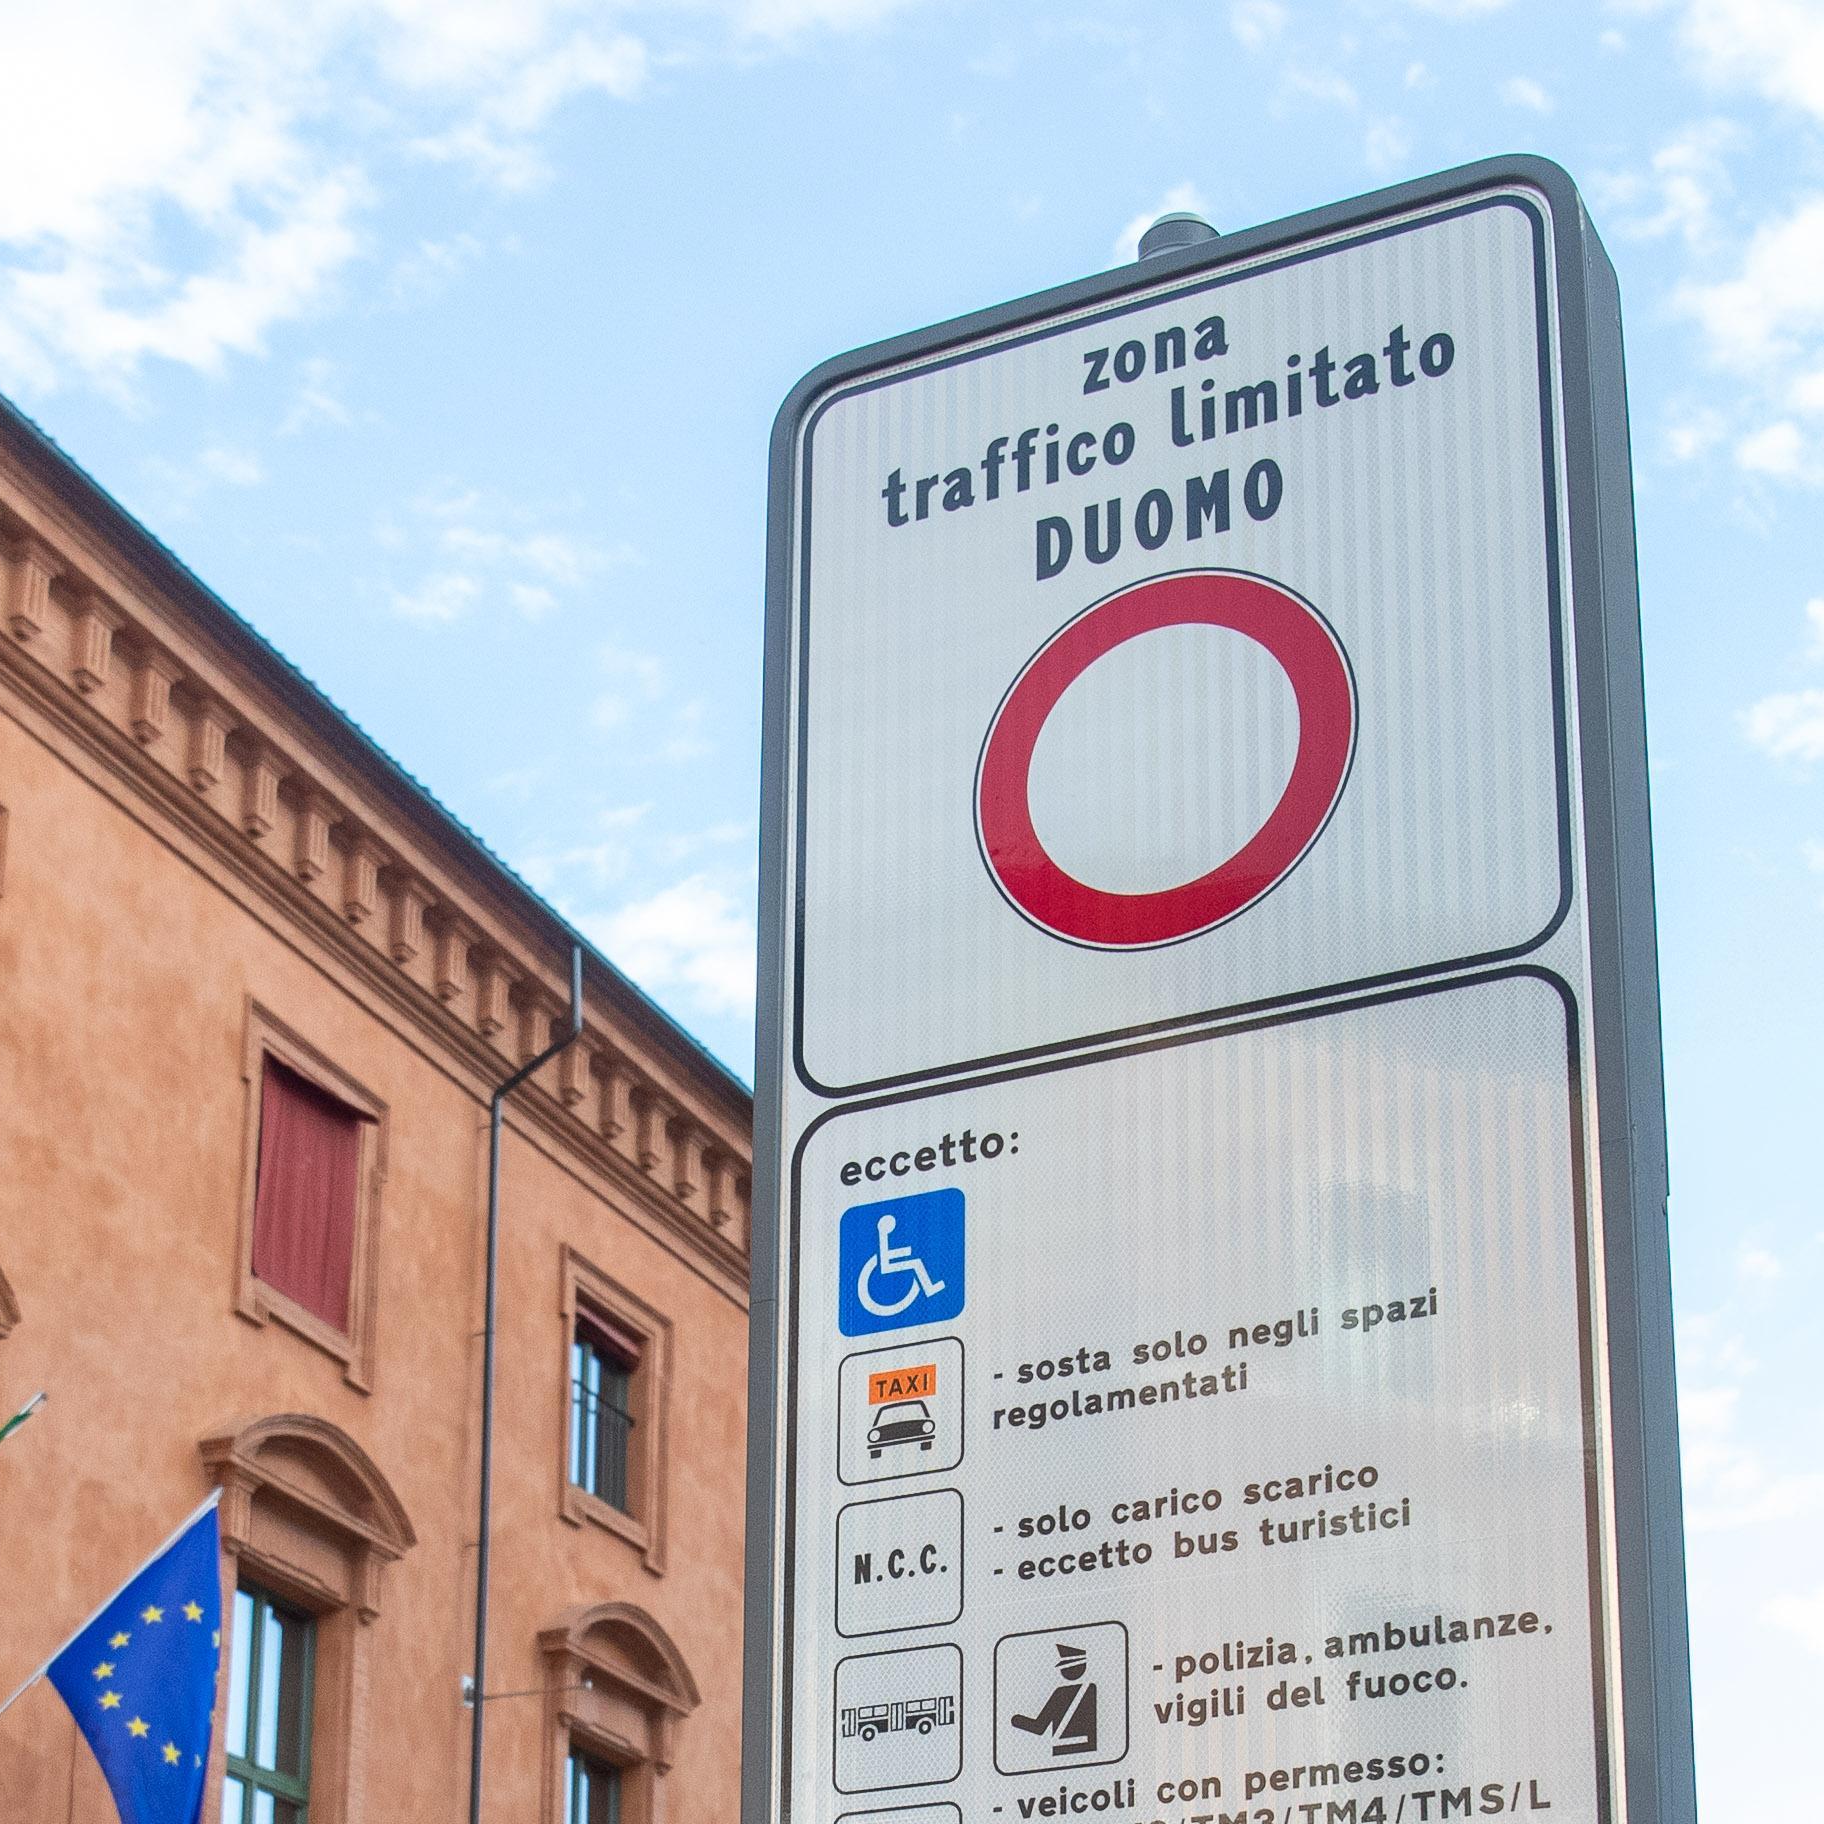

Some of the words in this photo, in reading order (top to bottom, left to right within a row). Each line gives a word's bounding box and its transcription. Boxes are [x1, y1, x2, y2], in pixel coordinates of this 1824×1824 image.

[1083, 315, 1228, 394] zona
[881, 420, 1135, 528] traffico
[1170, 325, 1456, 448] limitato
[1036, 457, 1284, 581] DUOMO
[840, 1129, 1019, 1186] eccetto:
[1017, 1347, 1111, 1384] sosta
[1133, 1330, 1207, 1364] solo
[1229, 1307, 1319, 1348] negli
[1341, 1287, 1438, 1332] spazi
[877, 1373, 928, 1399] TAXI
[993, 1363, 1248, 1430] regolamentati
[1017, 1505, 1091, 1538] solo
[1111, 1488, 1222, 1523] carico
[1243, 1464, 1379, 1505] scarico
[854, 1544, 947, 1585] N.C.C.
[1018, 1539, 1152, 1581] eccetto
[1174, 1531, 1239, 1559] bus
[1259, 1497, 1410, 1546] turistici
[1324, 1611, 1553, 1659] ambulanze,
[1154, 1686, 1245, 1727] vigili
[1266, 1677, 1325, 1711] del
[1346, 1666, 1469, 1700] fuoco.
[1018, 1779, 1135, 1820] veicoli
[1157, 1776, 1222, 1804] con
[1244, 1752, 1444, 1800] permesso:
